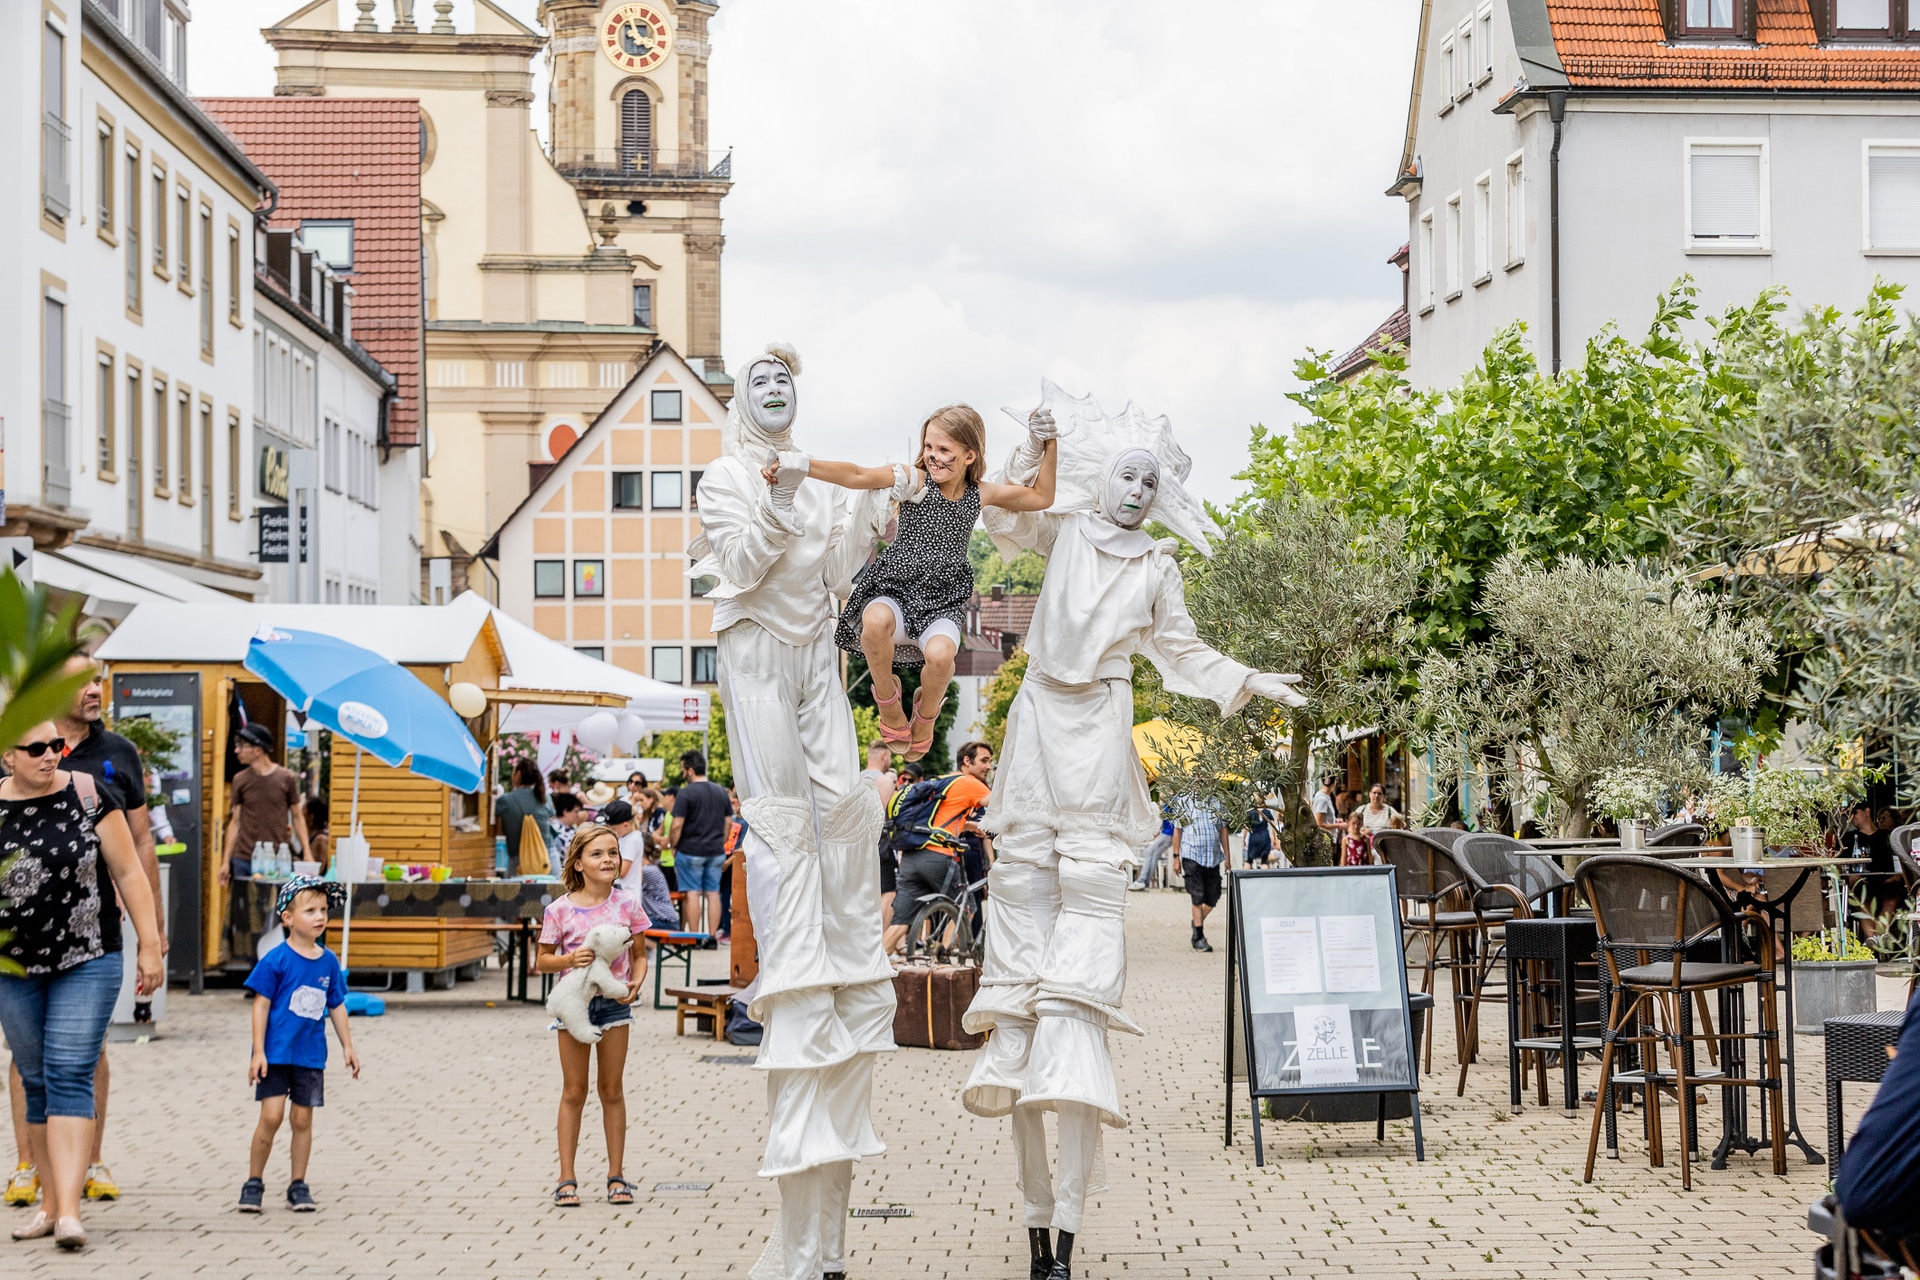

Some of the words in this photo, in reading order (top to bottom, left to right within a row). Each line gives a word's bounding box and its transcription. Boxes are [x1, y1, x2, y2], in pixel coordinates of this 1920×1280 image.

[131, 687, 174, 698] Marktplatz
[1306, 1045, 1349, 1061] ZELLE
[1314, 1067, 1343, 1075] KITCHEN
